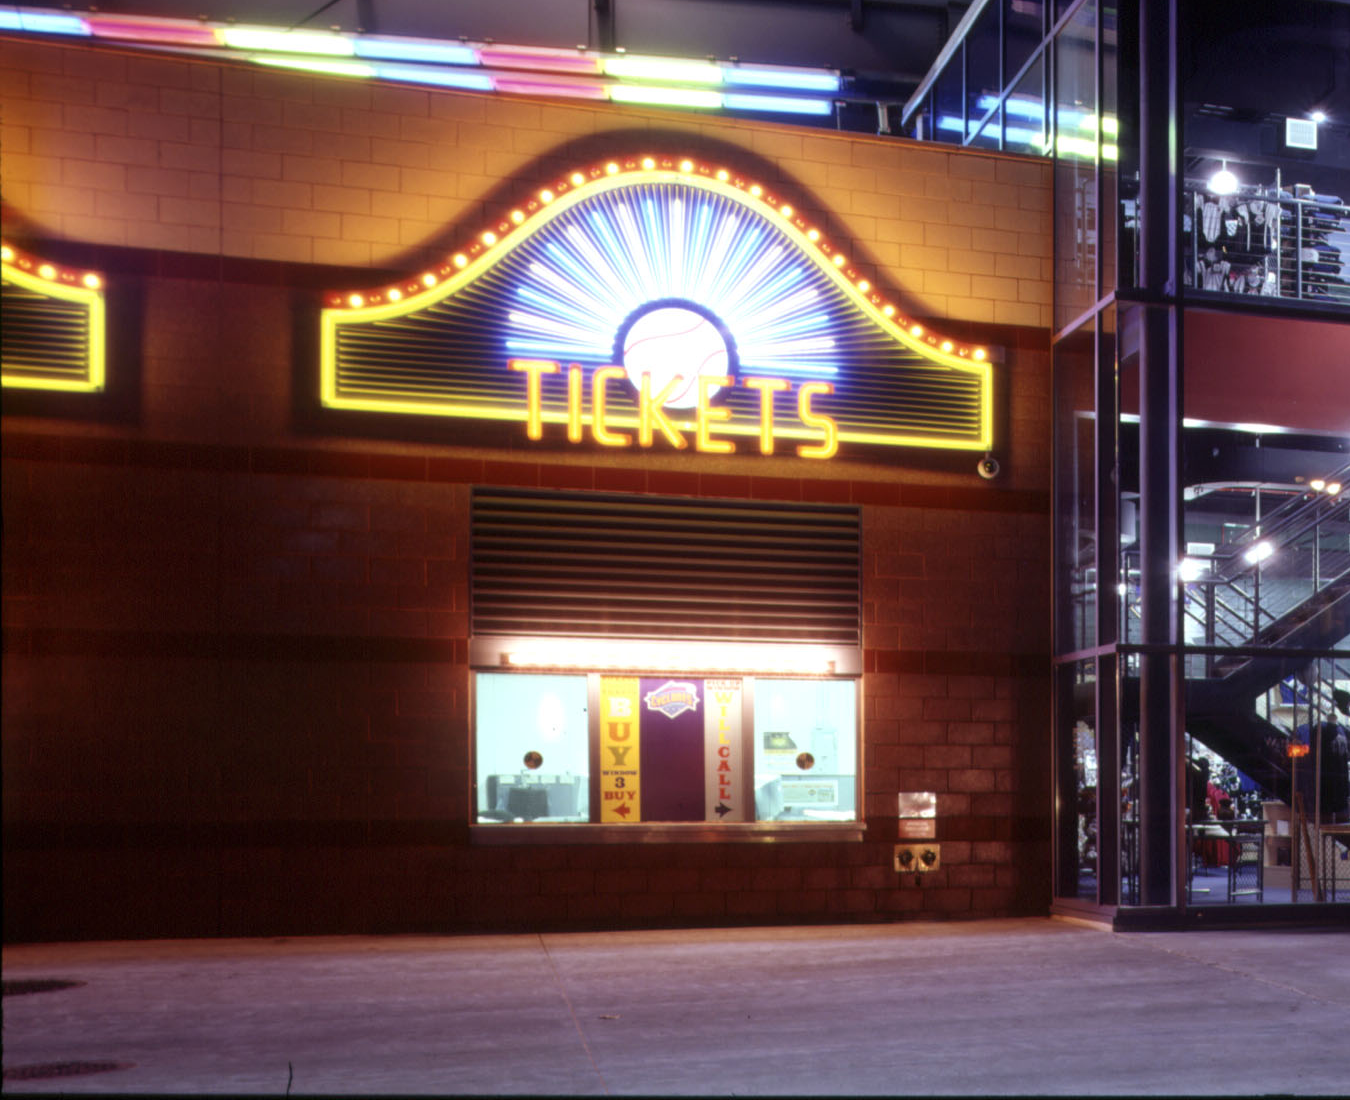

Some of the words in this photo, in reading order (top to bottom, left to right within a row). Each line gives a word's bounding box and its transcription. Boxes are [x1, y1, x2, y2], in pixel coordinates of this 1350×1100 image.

[507, 359, 839, 459] TICKETS
[607, 697, 632, 766] BUY
[604, 791, 636, 800] BUY
[615, 777, 625, 788] 3
